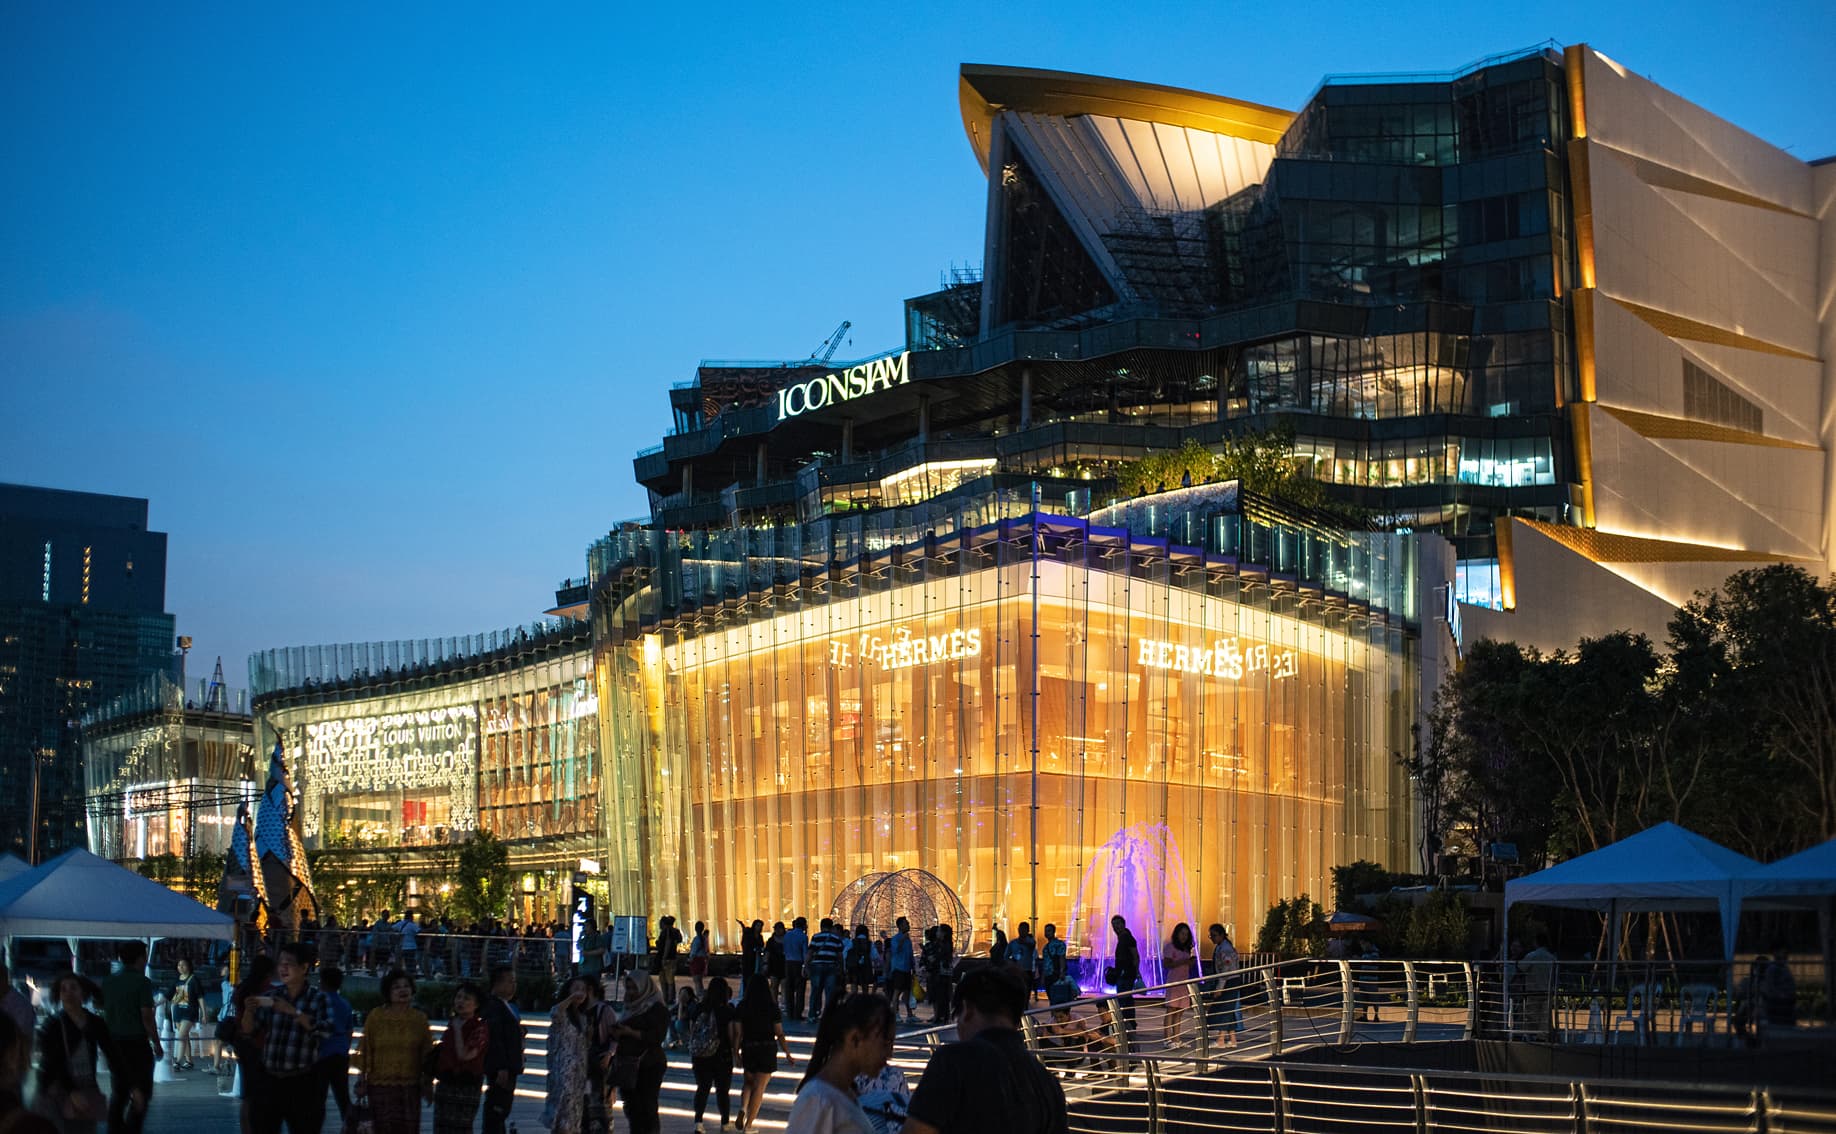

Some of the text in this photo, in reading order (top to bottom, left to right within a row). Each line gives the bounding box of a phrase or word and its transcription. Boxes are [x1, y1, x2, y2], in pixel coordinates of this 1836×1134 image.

[777, 351, 911, 420] ICONSIAM
[383, 722, 462, 745] LOUIS VUITTON
